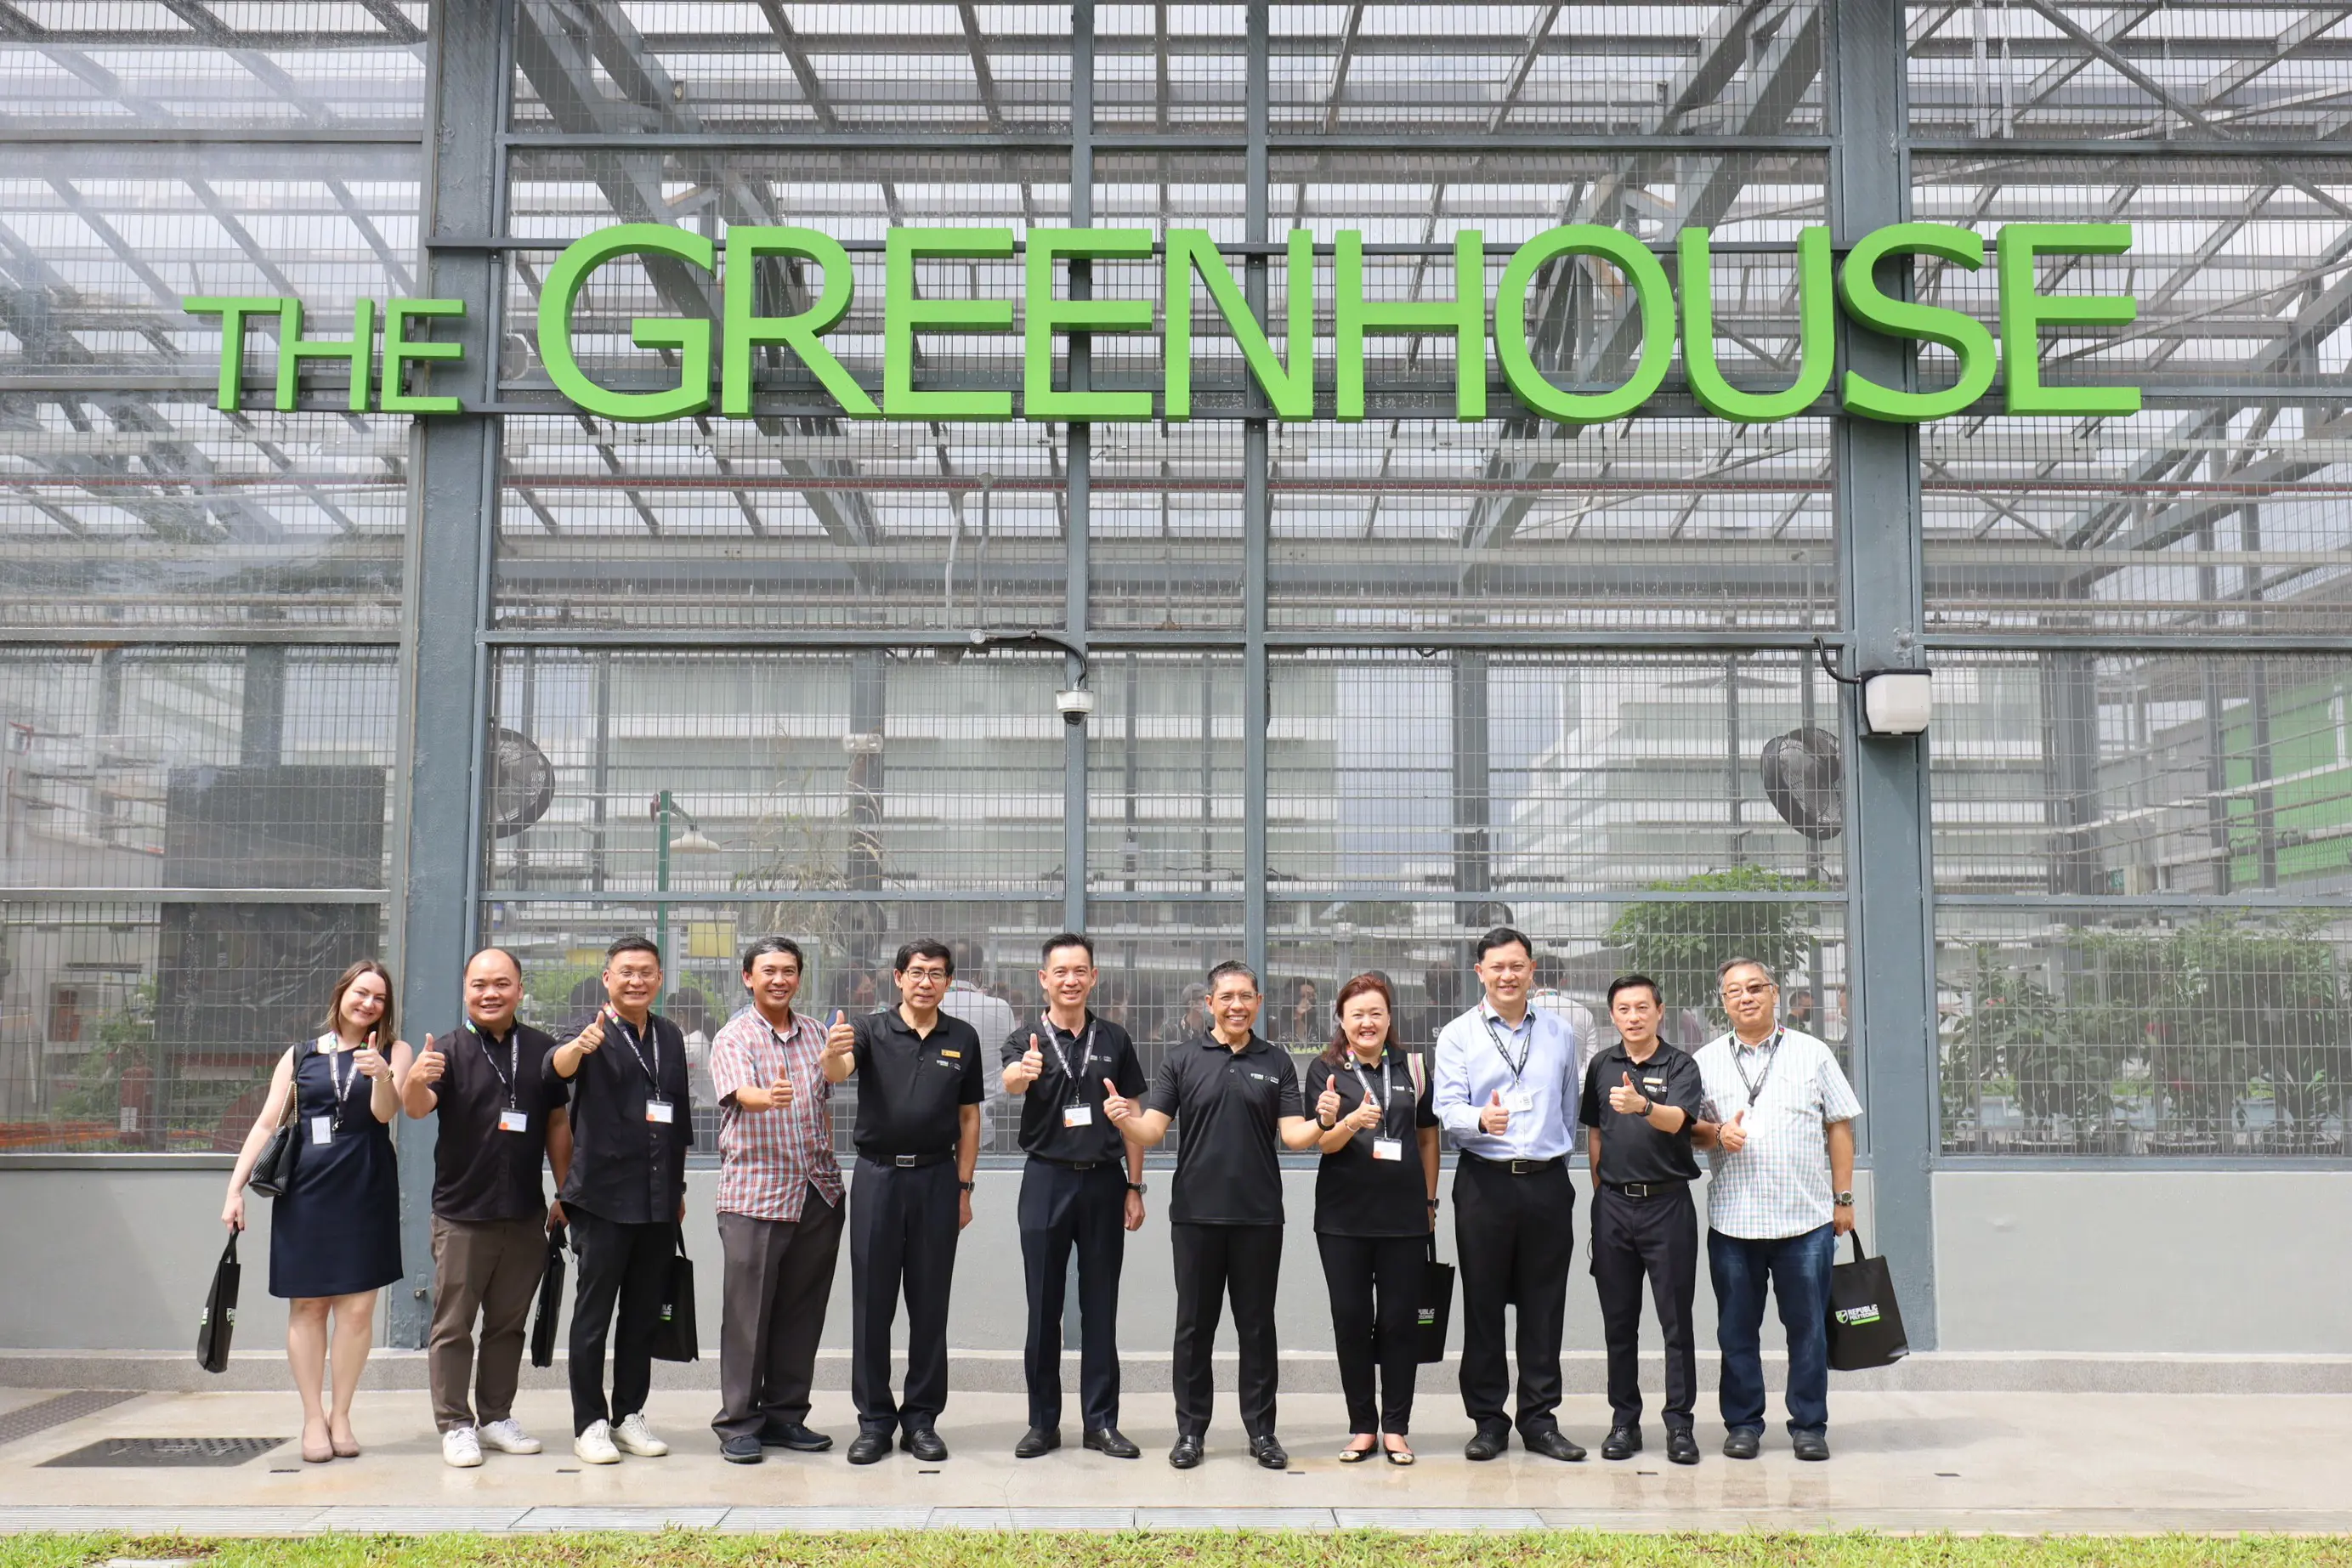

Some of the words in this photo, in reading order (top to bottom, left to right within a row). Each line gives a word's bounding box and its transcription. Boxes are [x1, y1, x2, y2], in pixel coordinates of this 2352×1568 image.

[183, 296, 466, 415] THE
[540, 224, 2143, 424] GREENHOUSE
[1847, 1304, 1879, 1316] REPUBLIC
